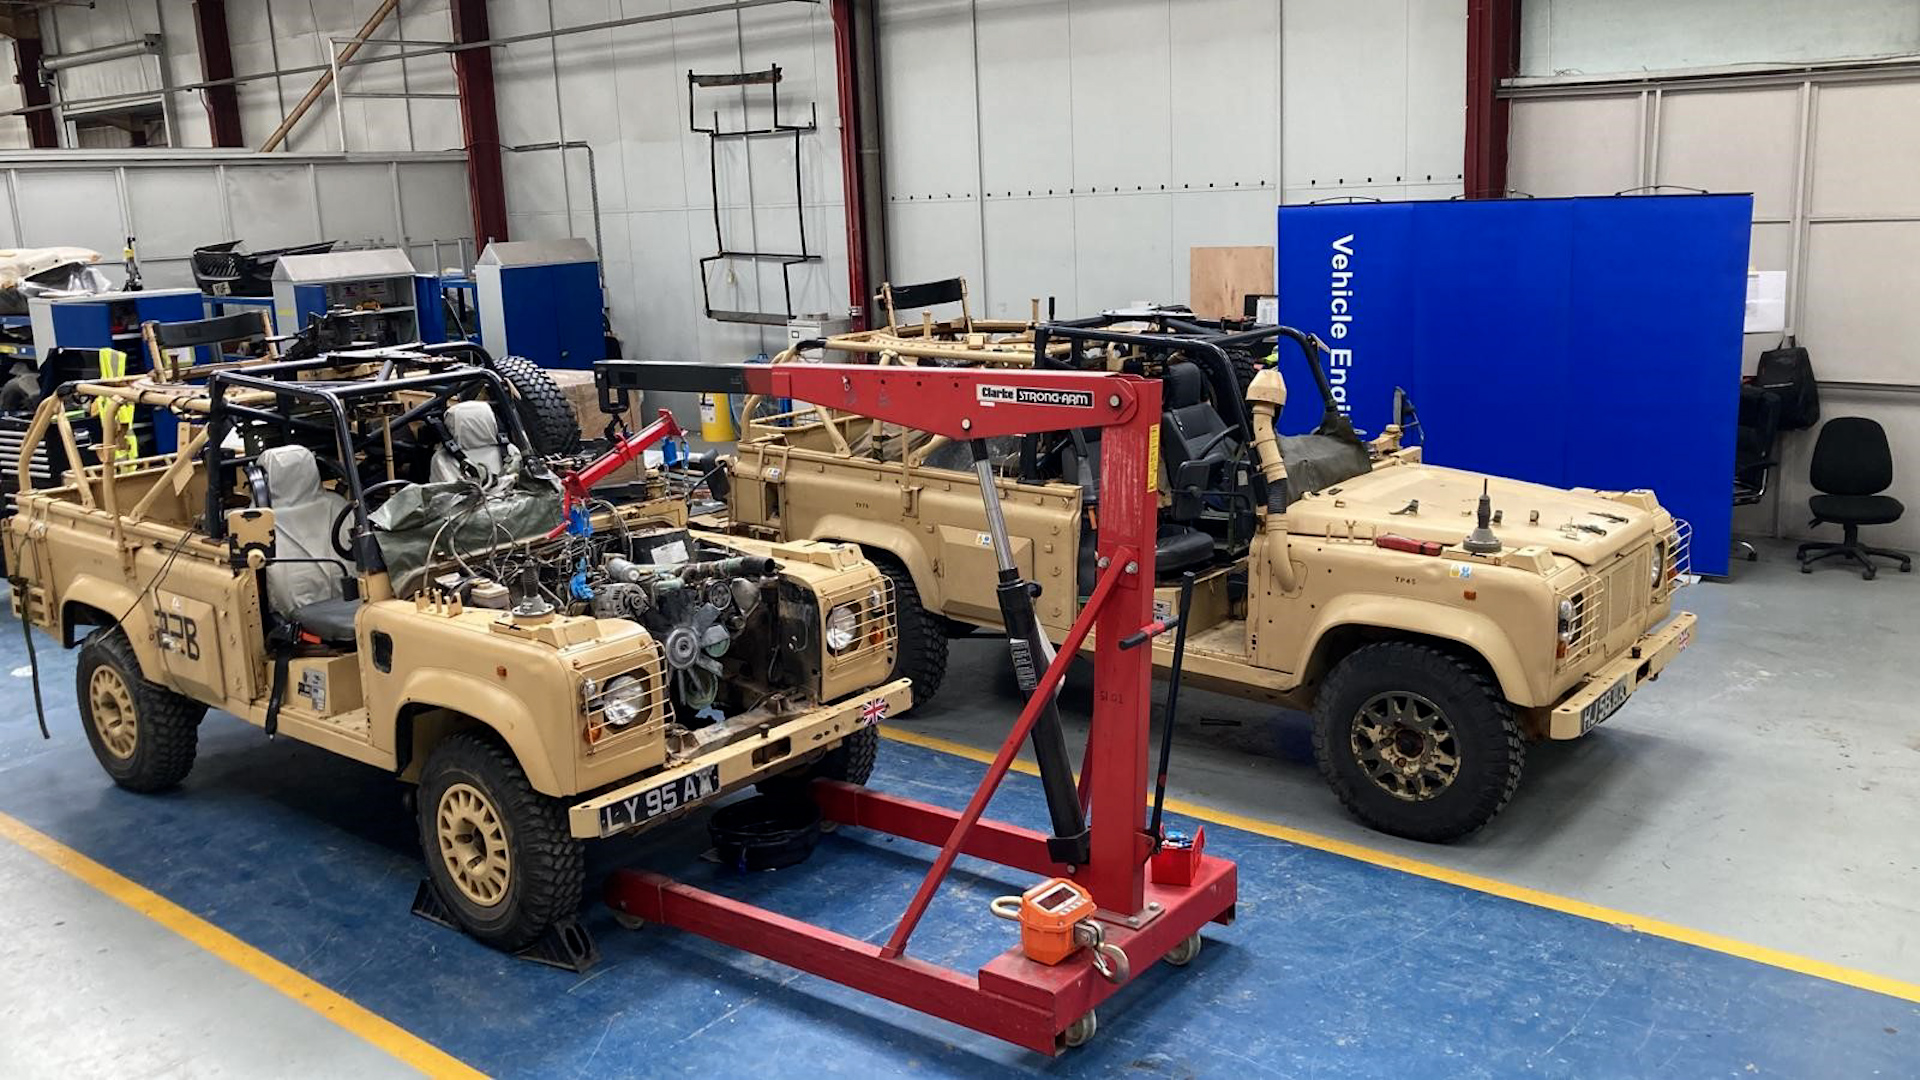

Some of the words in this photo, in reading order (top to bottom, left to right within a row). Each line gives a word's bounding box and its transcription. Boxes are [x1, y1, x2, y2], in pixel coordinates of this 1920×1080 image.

[1330, 234, 1354, 339] Vehicle
[982, 387, 1015, 399] Clarke
[1330, 349, 1352, 416] Engi
[606, 797, 639, 832] LY
[645, 782, 678, 817] 95
